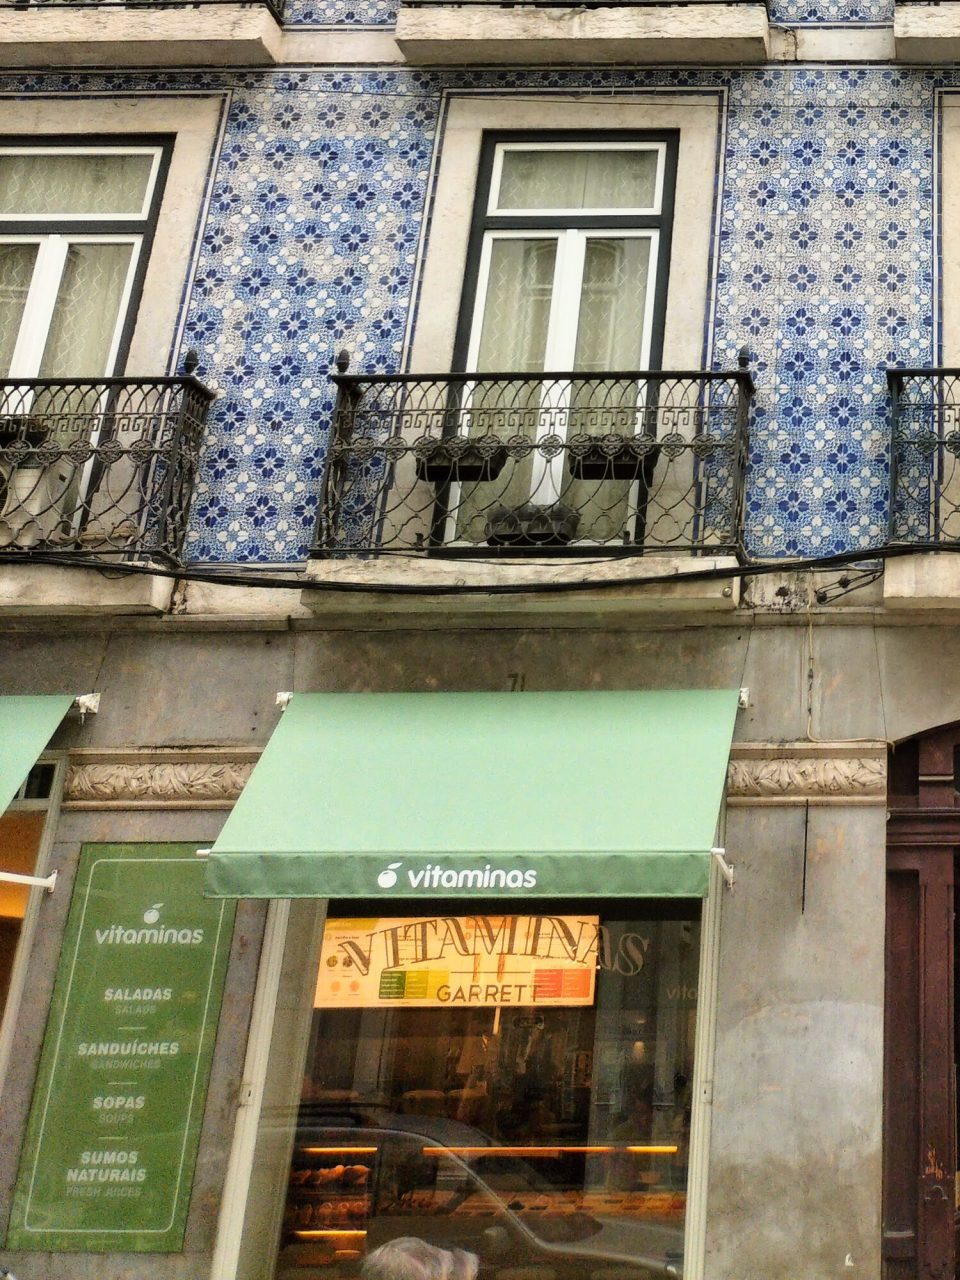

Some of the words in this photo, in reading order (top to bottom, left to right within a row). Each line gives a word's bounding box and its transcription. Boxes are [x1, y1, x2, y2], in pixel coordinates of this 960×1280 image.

[407, 864, 537, 888] vitaminas
[95, 925, 204, 944] vitaminas
[338, 916, 650, 976] VITAMINAS
[104, 988, 173, 1000] SALADAS
[437, 984, 542, 1002] GARRETT
[78, 1039, 179, 1056] SANDUÍCHES
[93, 1096, 145, 1109] SOPAS
[81, 1151, 138, 1164] SUMOS
[66, 1169, 147, 1182] NATURAIS
